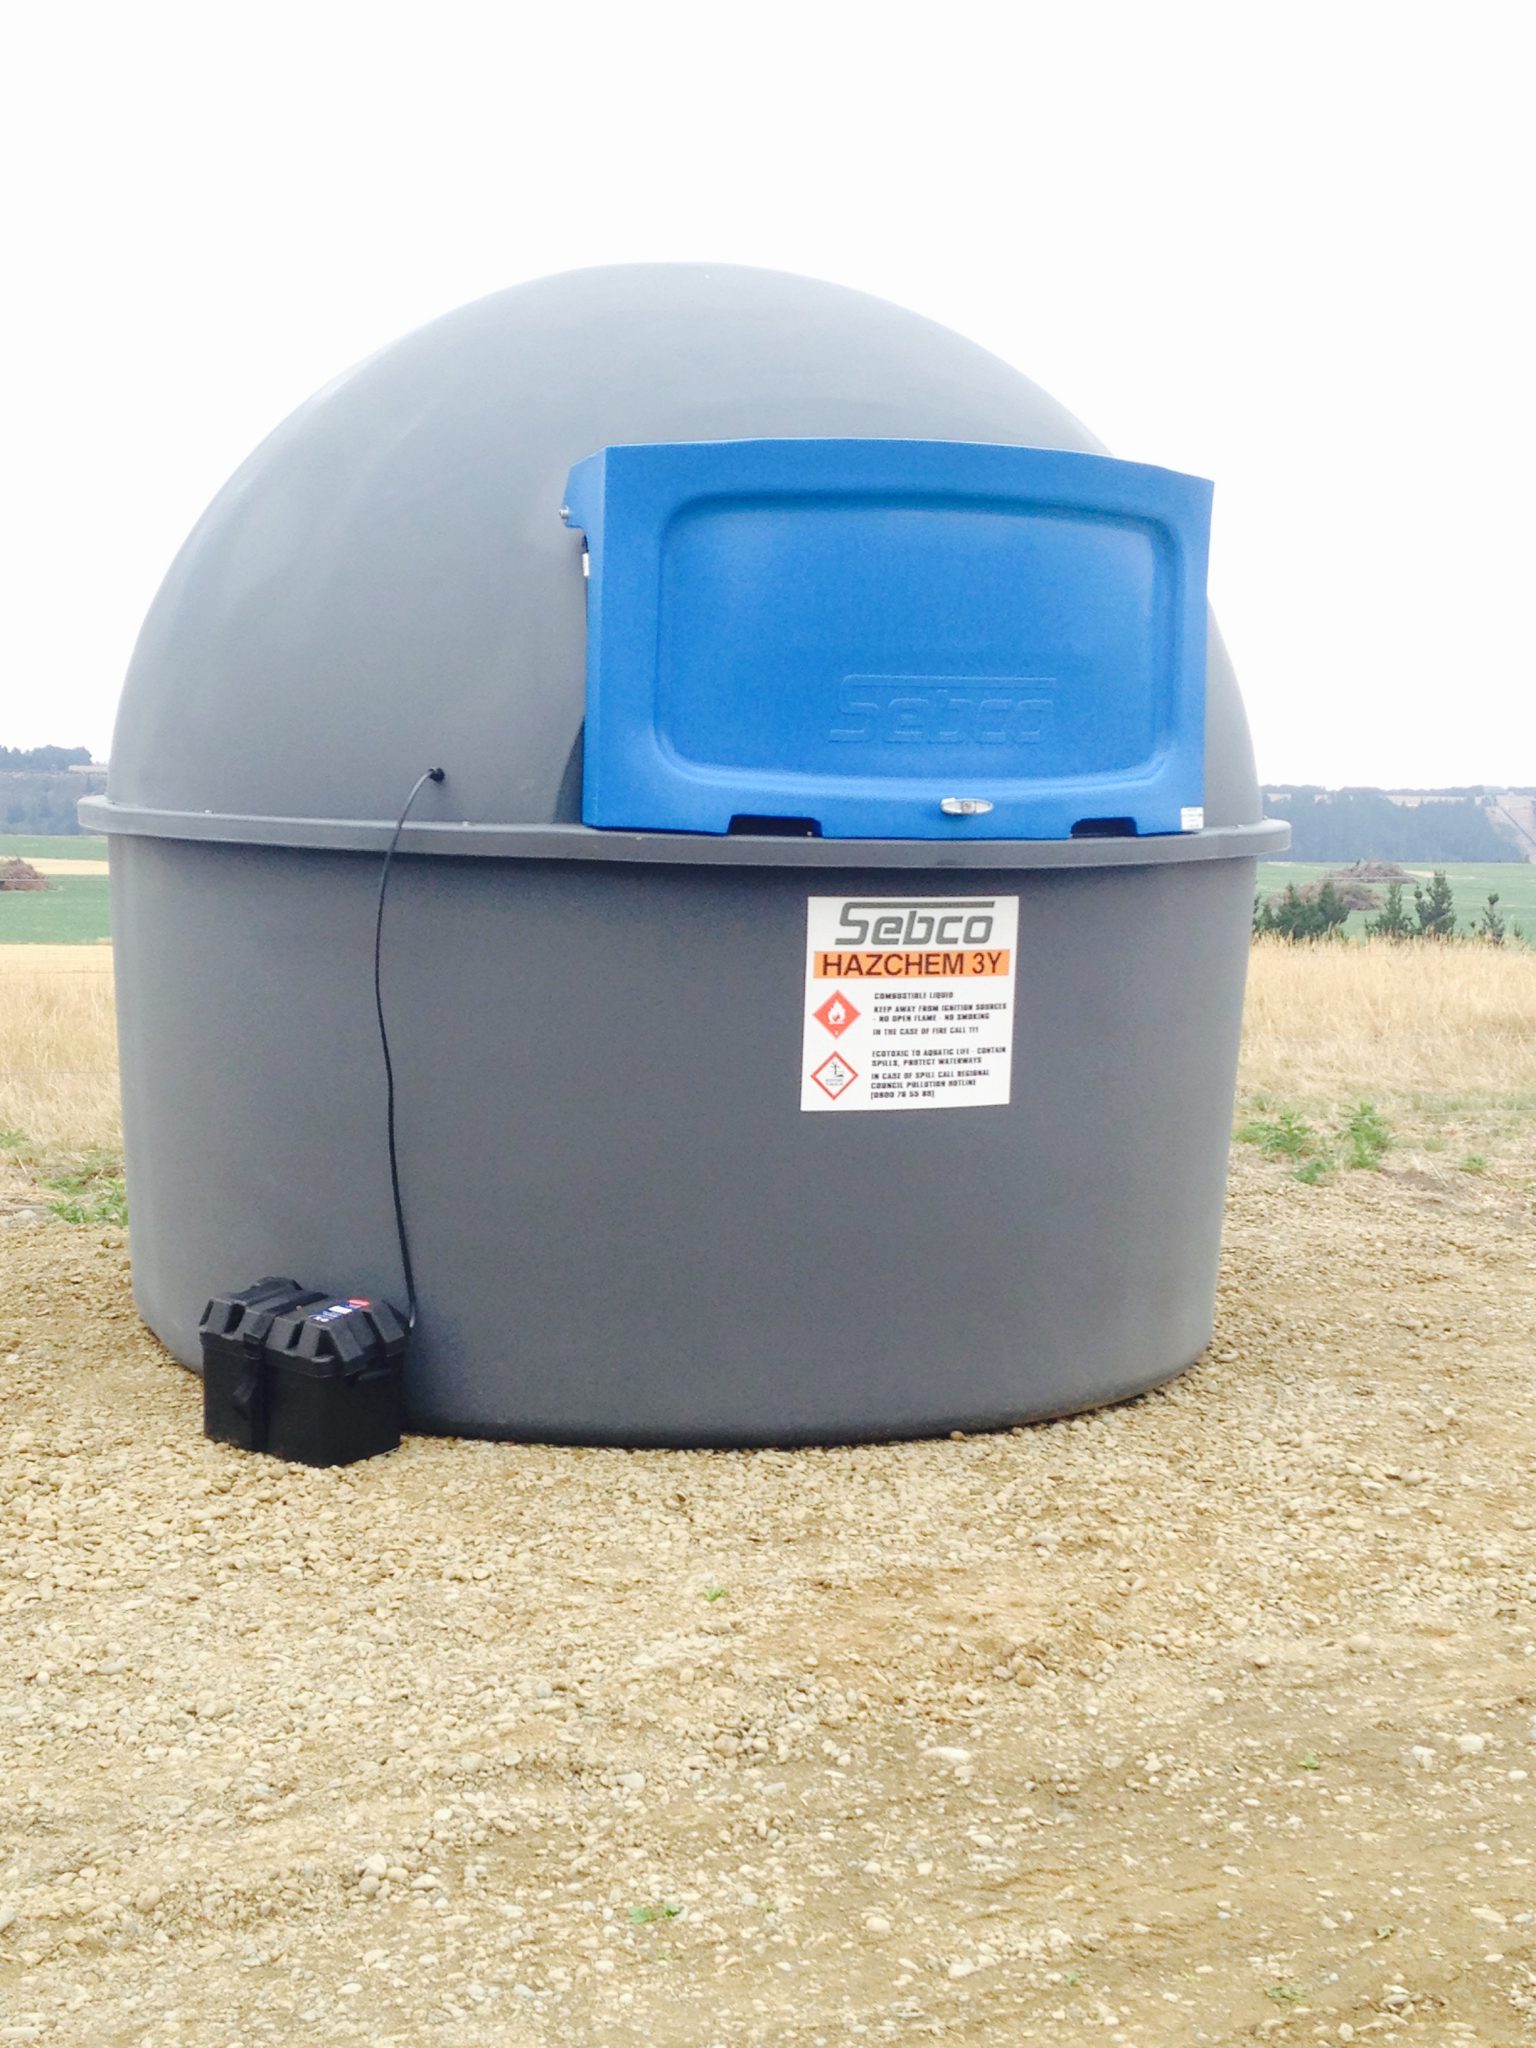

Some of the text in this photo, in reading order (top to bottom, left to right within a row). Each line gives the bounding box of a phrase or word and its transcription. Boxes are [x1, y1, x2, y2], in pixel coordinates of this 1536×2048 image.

[834, 901, 995, 945] Sebco
[822, 952, 1002, 975] HAZCHEM 3Y
[938, 1057, 982, 1065] WATERWAYS
